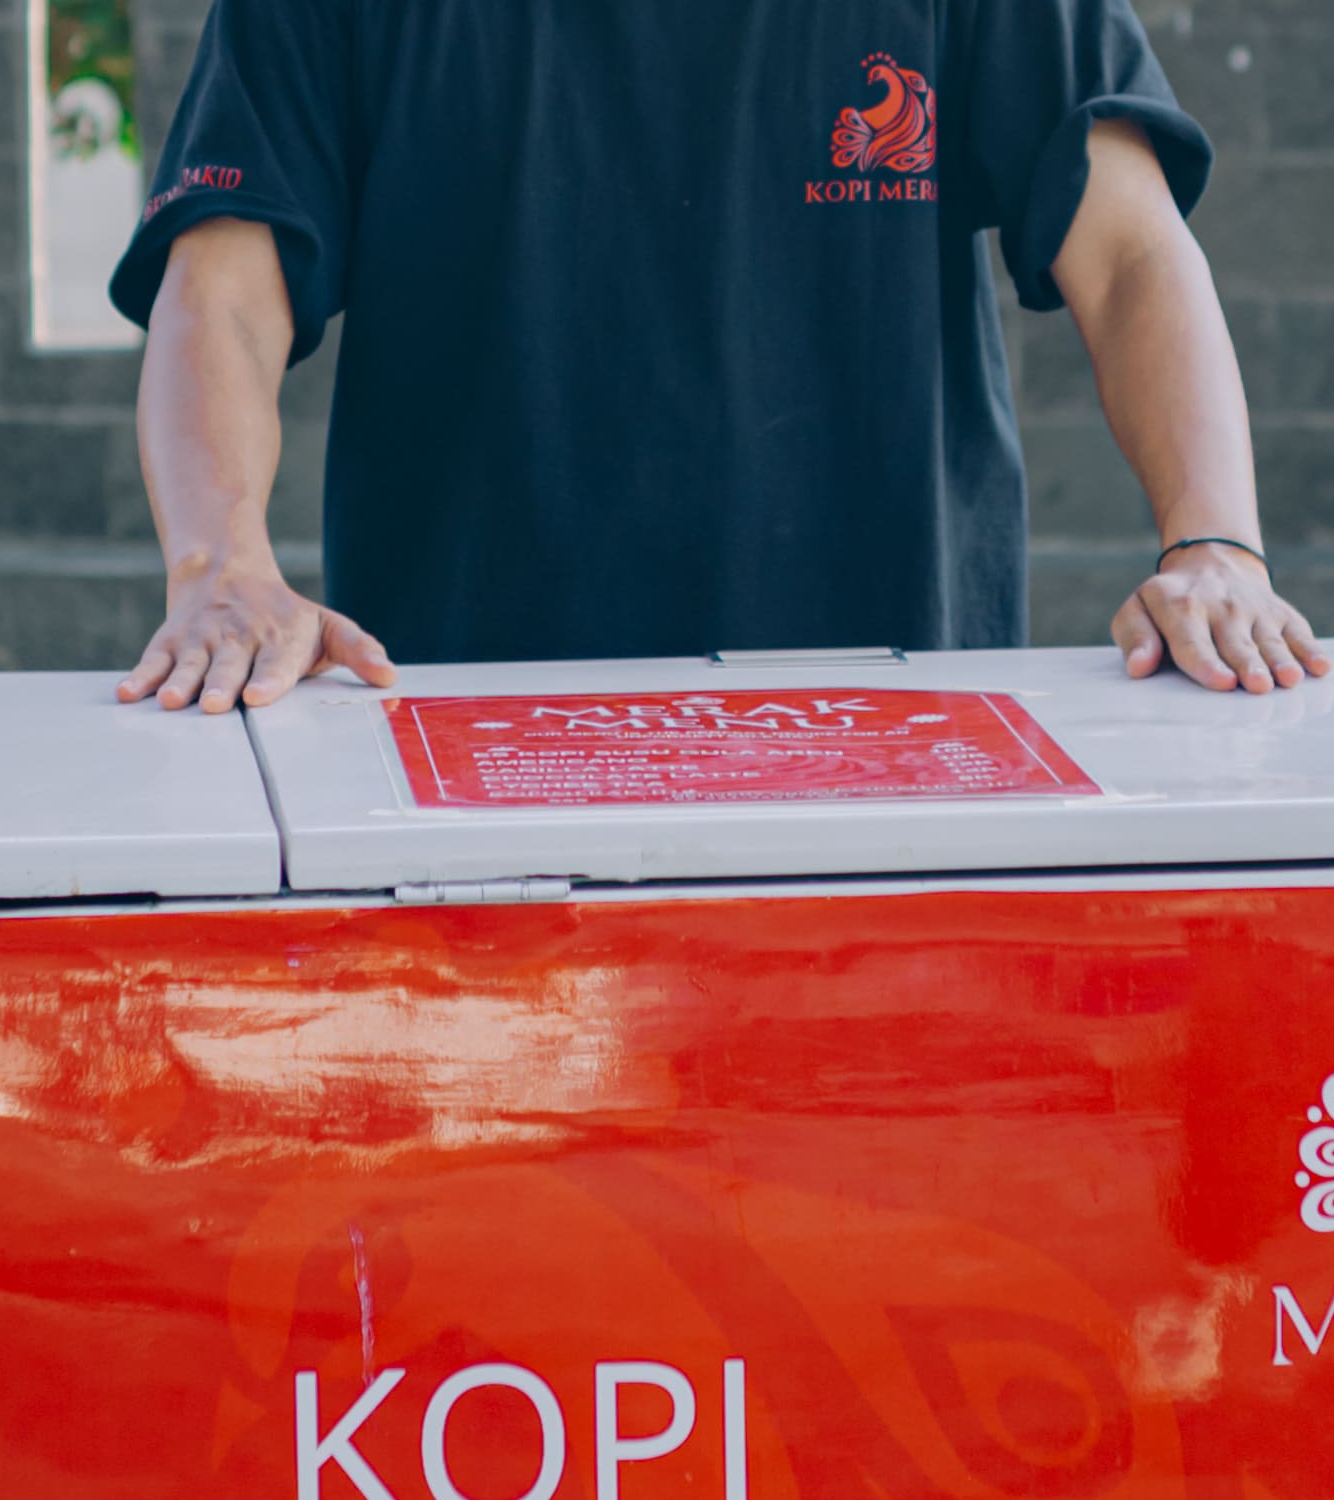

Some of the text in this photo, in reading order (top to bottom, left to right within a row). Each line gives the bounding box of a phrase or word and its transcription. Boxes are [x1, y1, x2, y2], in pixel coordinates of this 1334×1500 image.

[804, 180, 871, 203] KOPI
[531, 698, 880, 718] MERAK
[565, 716, 854, 730] MENU
[476, 758, 648, 767] AMERICANO
[478, 764, 700, 774] VANILLA LATTE
[481, 771, 761, 782] CHOCOLATE LATTE
[484, 782, 600, 790] LYCHEE
